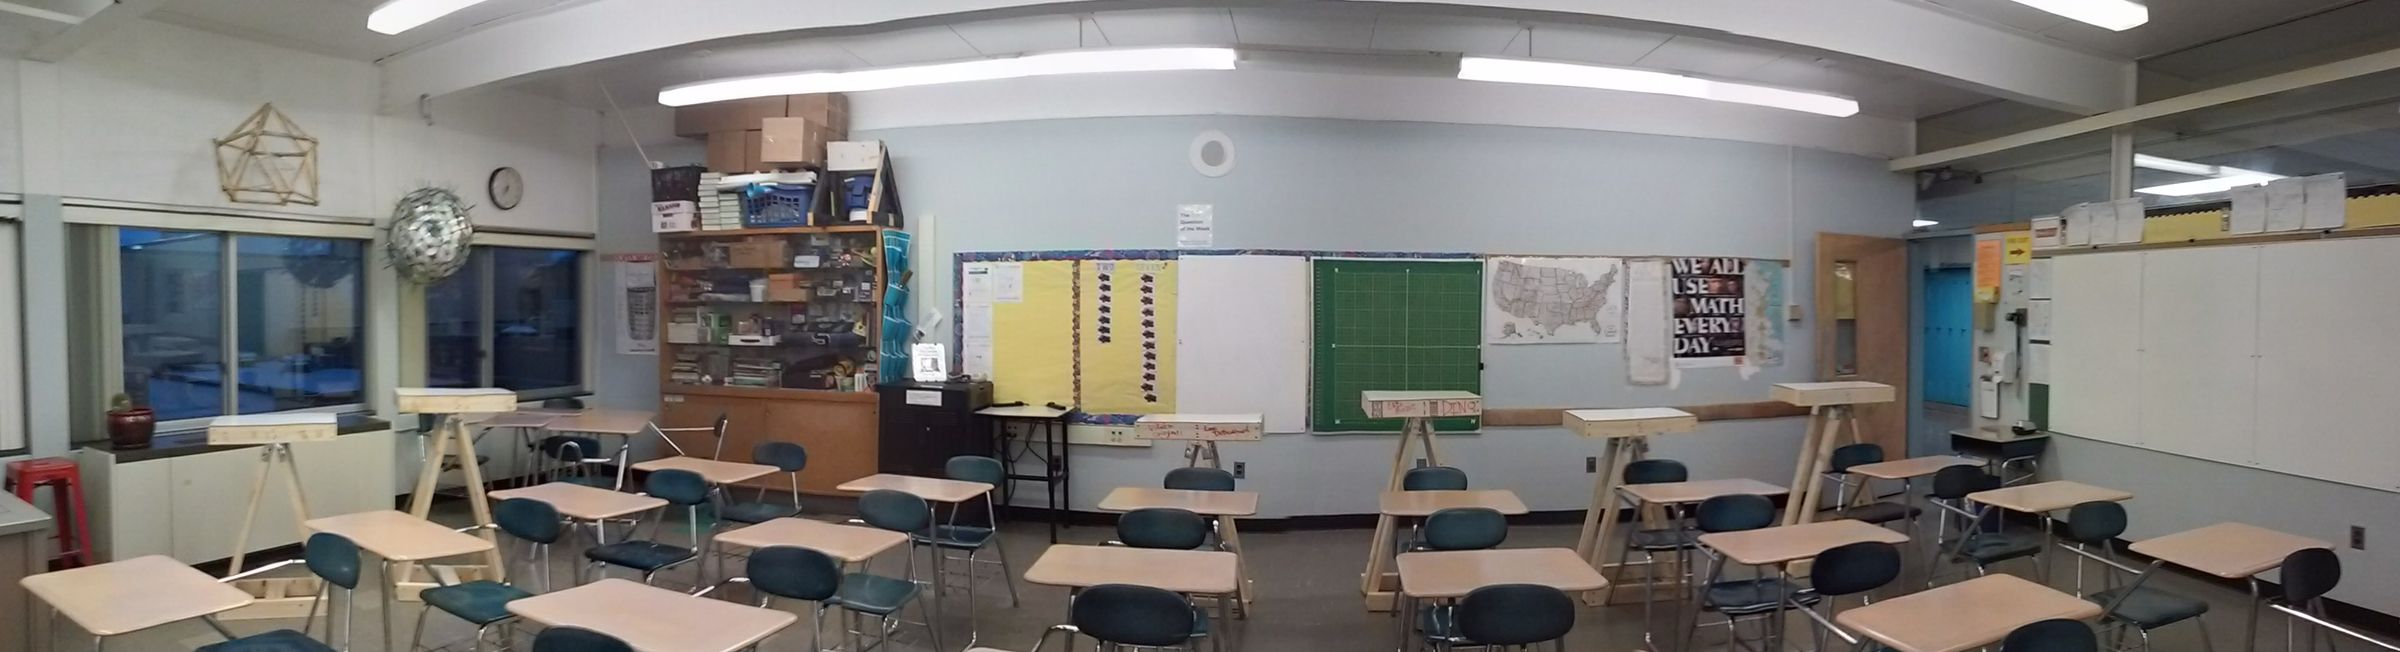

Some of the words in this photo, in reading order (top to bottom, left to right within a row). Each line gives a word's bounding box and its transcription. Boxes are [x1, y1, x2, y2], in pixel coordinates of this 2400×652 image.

[1671, 257, 1702, 275] WE
[1709, 257, 1744, 275] ALL
[1672, 277, 1709, 295] USE
[1689, 297, 1744, 314] MATH
[1674, 317, 1731, 334] EVERY
[1674, 336, 1710, 354] DAY
